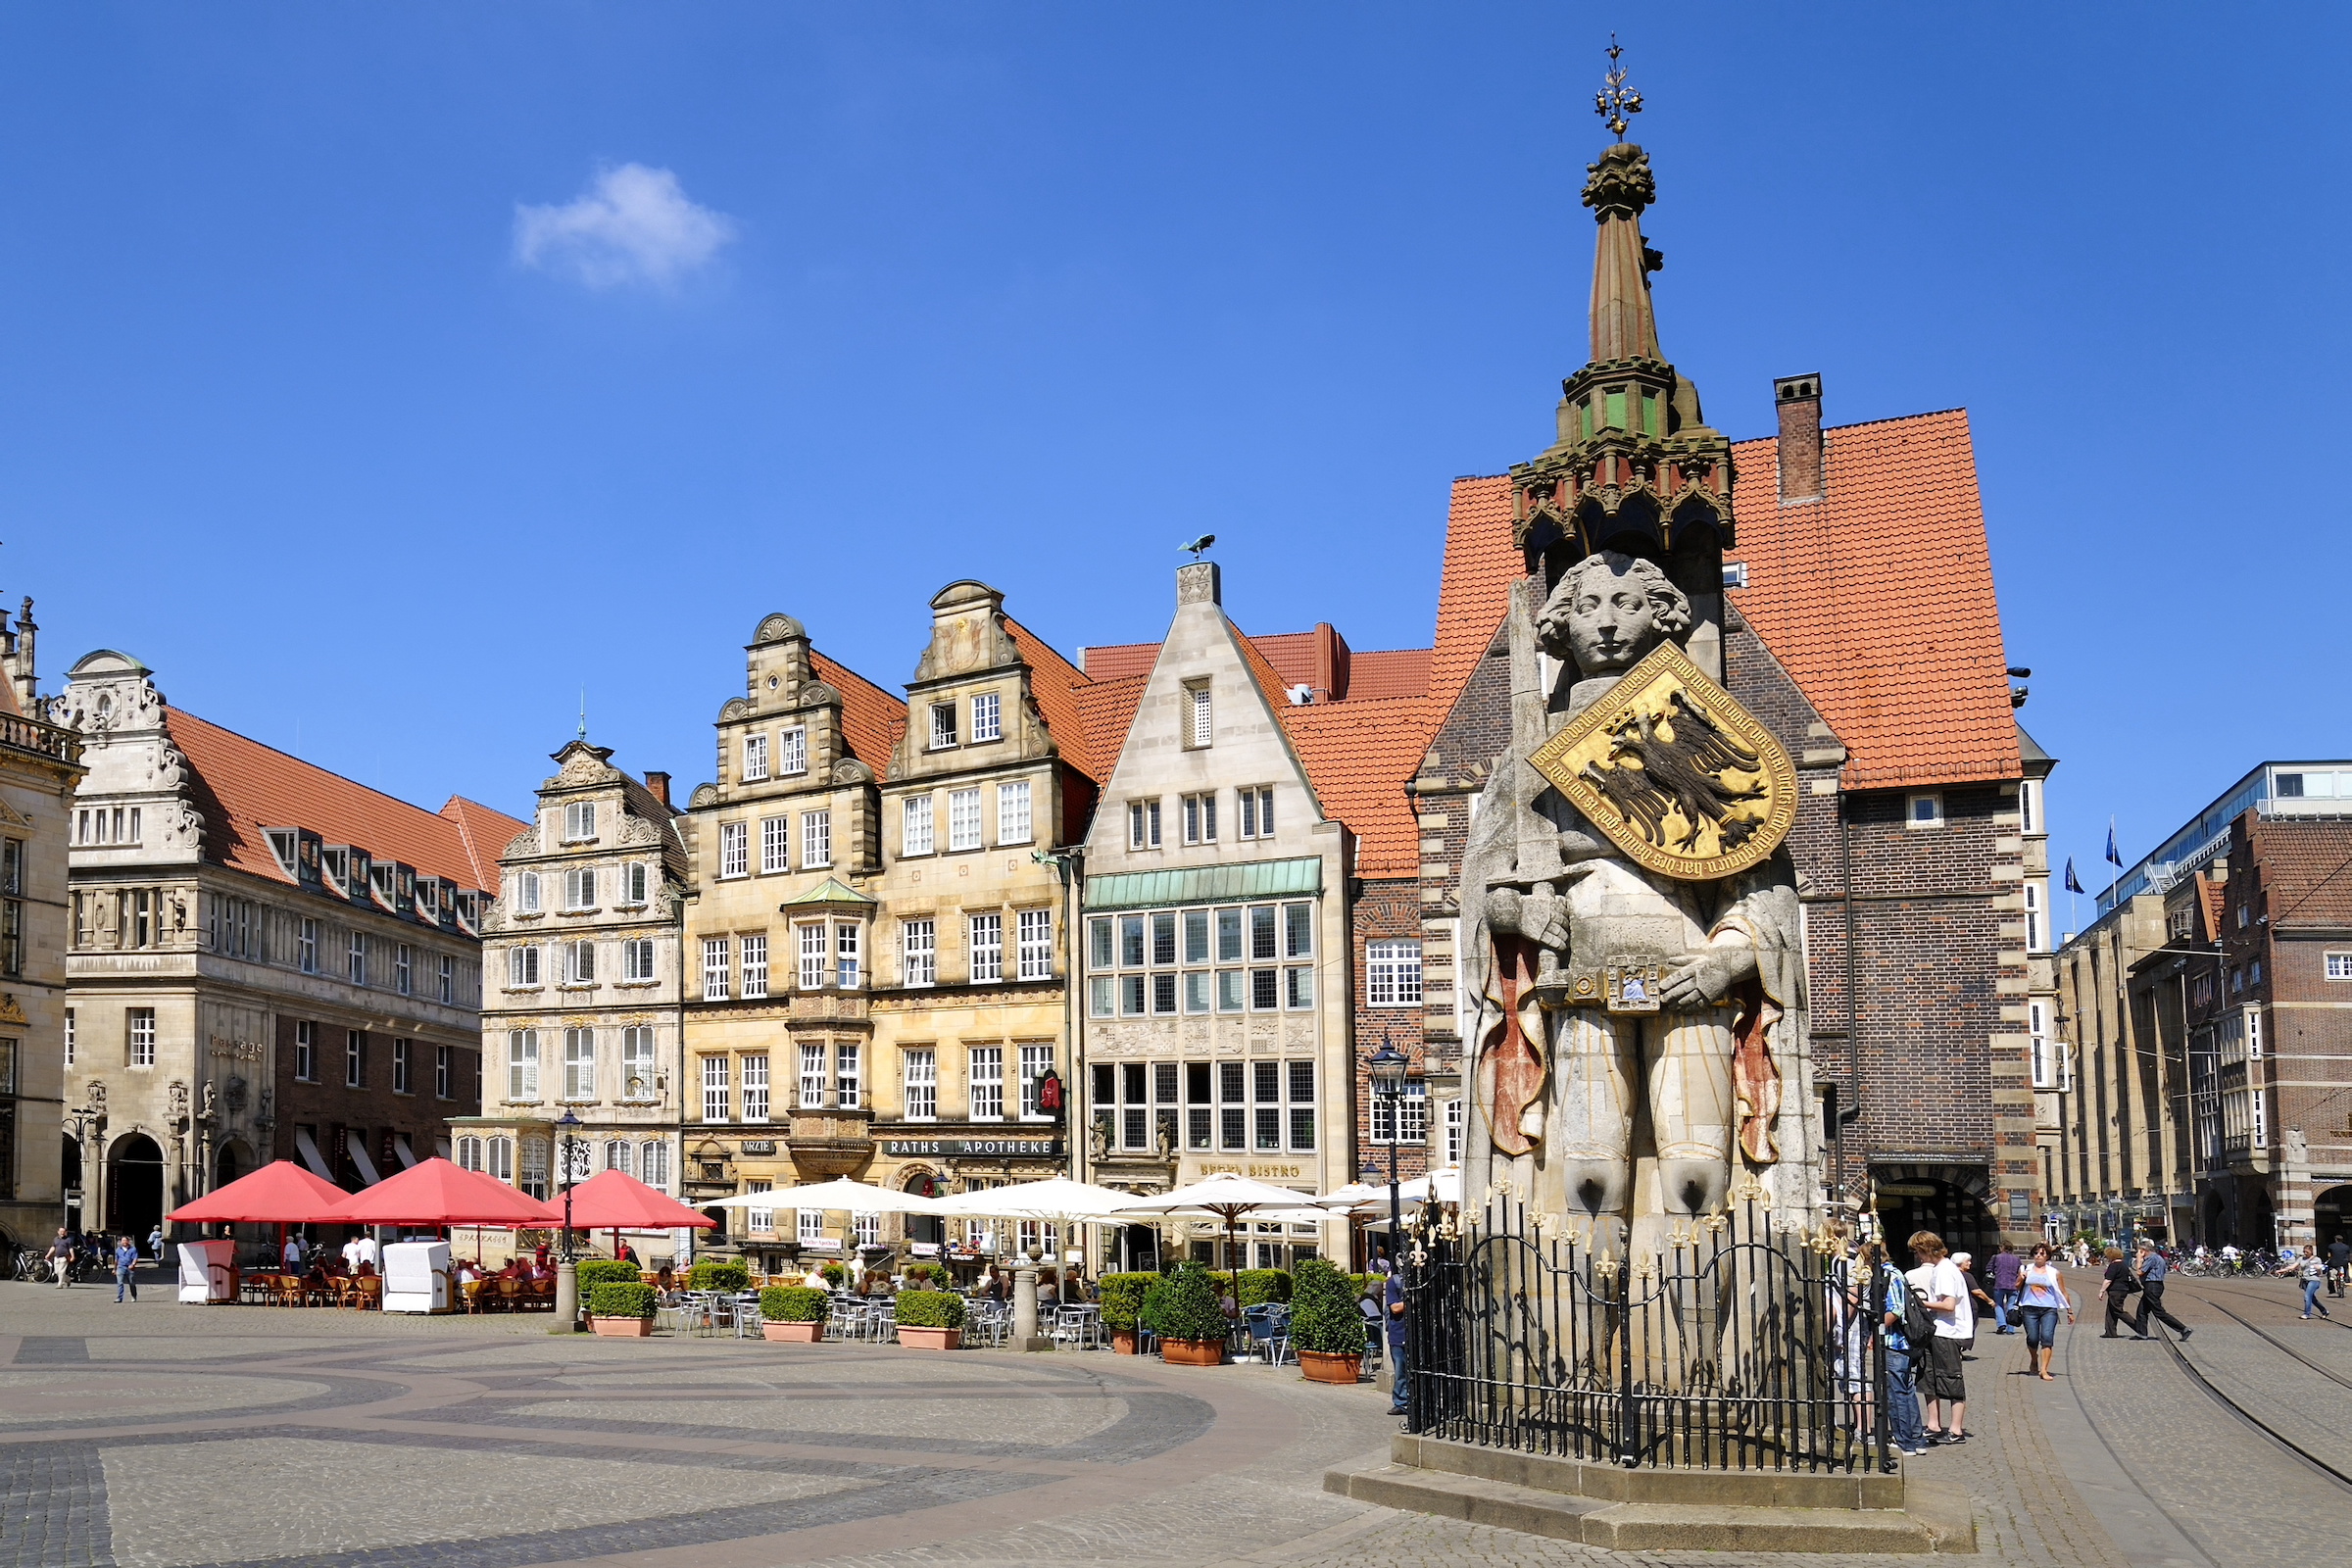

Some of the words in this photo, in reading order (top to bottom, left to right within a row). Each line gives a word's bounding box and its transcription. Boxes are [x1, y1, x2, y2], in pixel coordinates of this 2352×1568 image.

[891, 1141, 940, 1153] RATHS
[963, 1141, 1052, 1153] APOTHEKE
[1249, 1164, 1299, 1177] BISTRO
